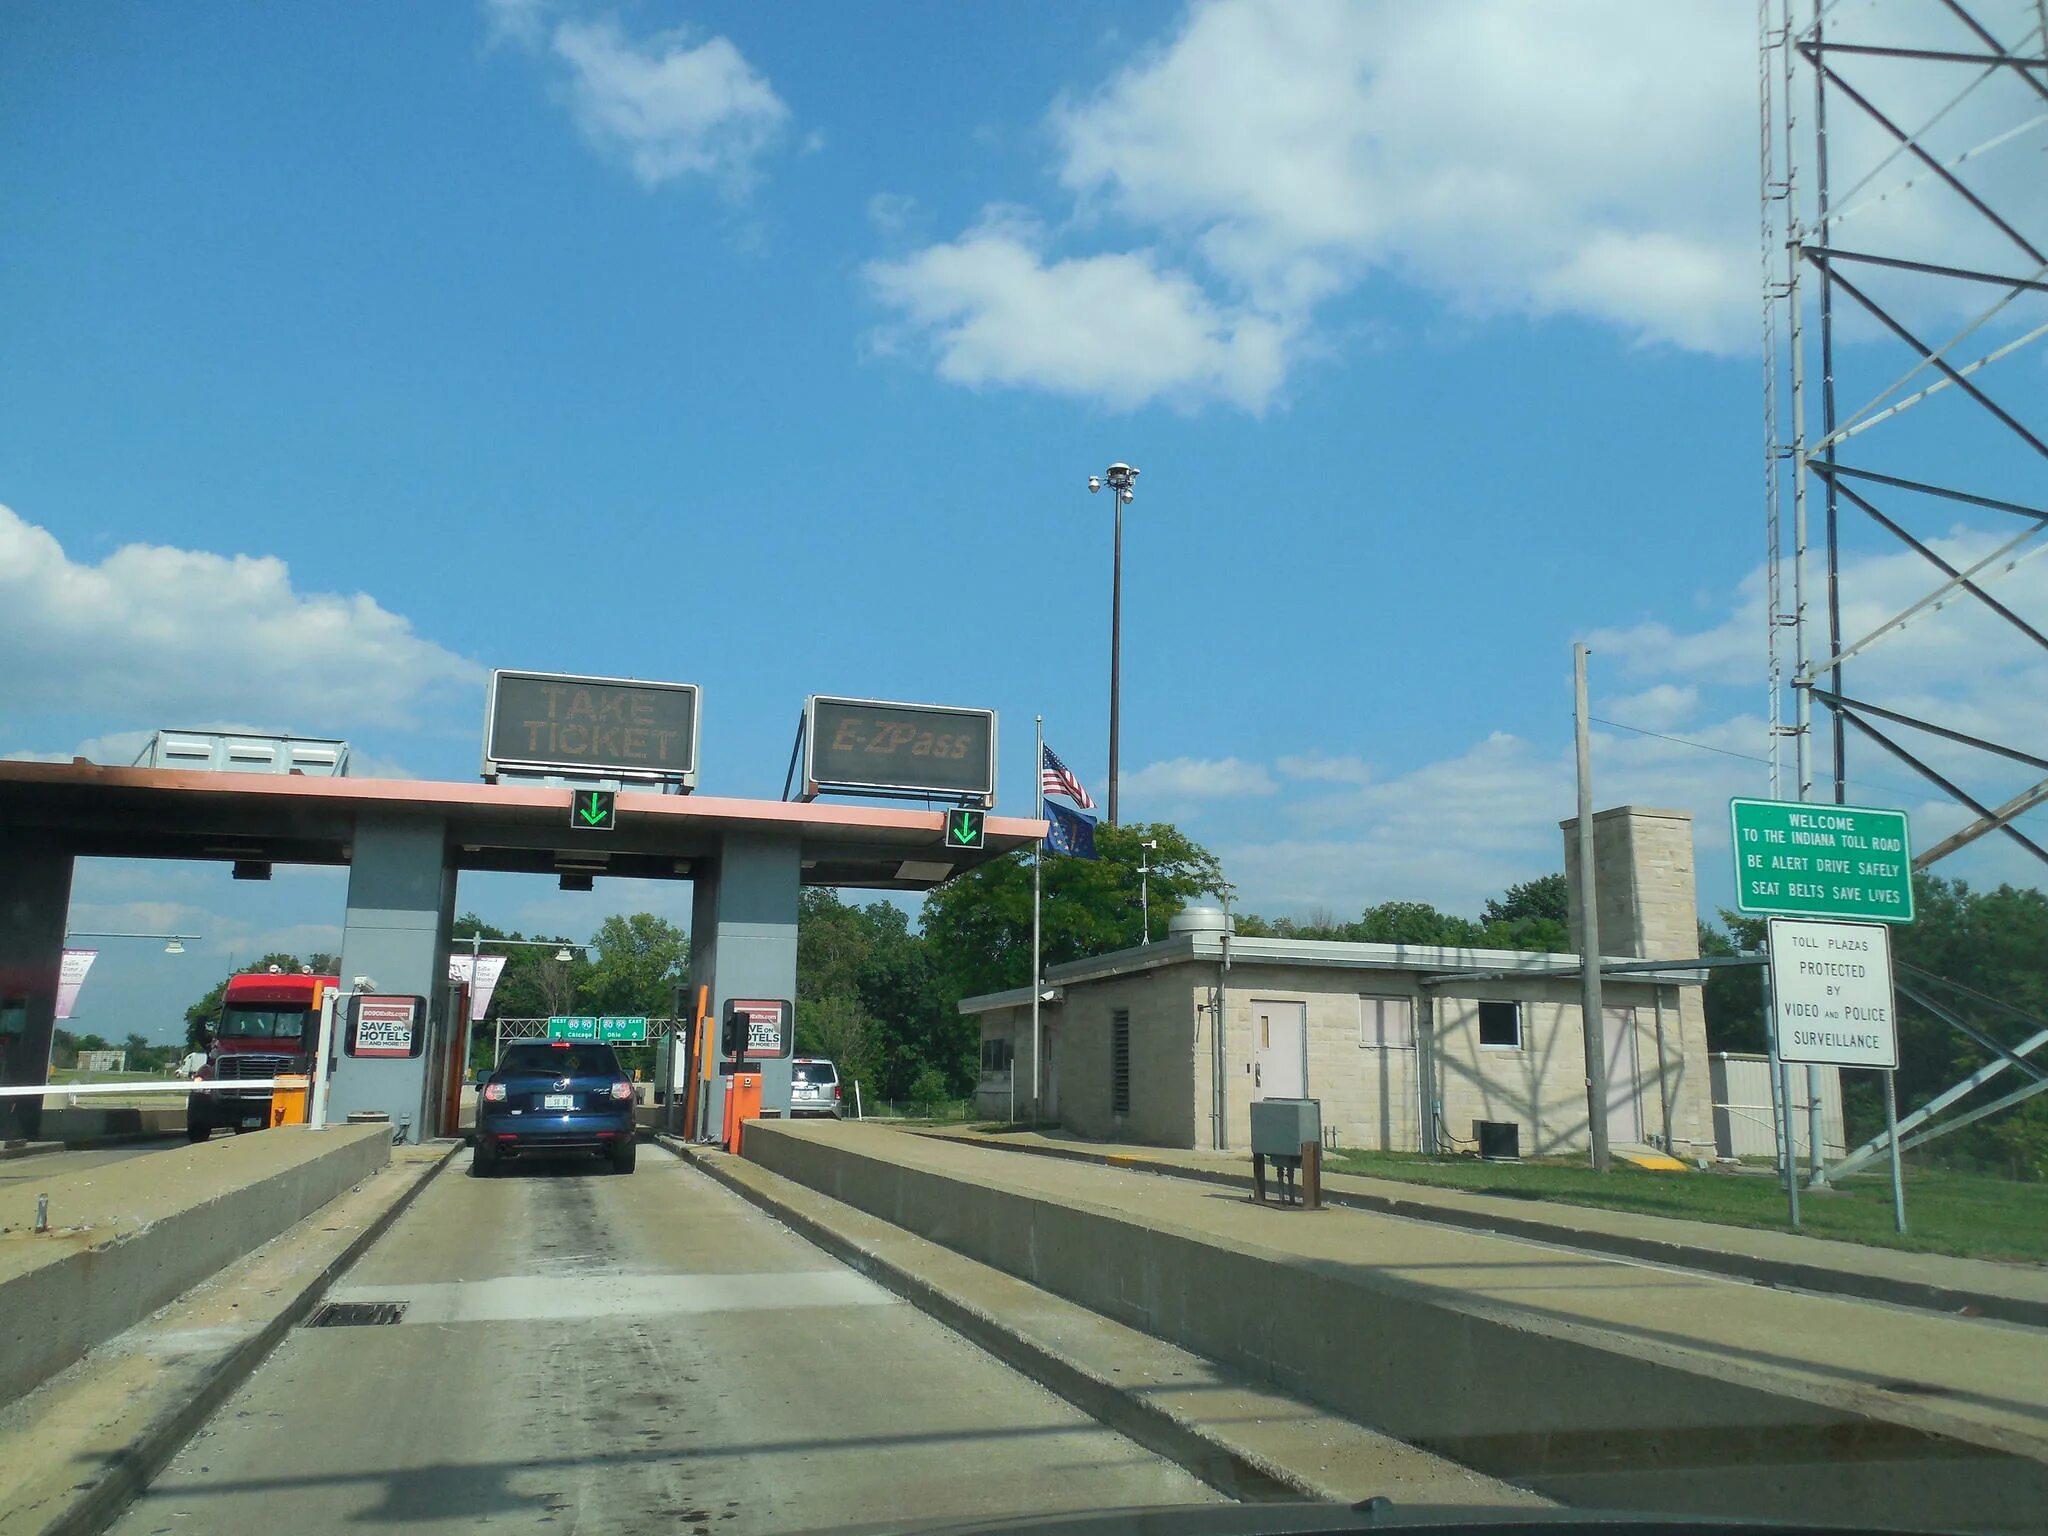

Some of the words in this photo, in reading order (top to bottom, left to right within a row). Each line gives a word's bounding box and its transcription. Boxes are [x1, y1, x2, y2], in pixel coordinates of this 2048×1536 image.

[541, 685, 657, 725] TAKE
[523, 720, 679, 760] TICKET
[831, 717, 972, 760] E-ZPass
[1788, 813, 1855, 831] WELCOME
[1743, 828, 1758, 842] TO
[1763, 829, 1786, 844] THE
[1791, 831, 1836, 847] INDIANA
[1841, 835, 1868, 849] TOLL
[1872, 837, 1901, 852] ROAD
[1747, 854, 1763, 868] BE
[1771, 855, 1808, 871] ALERT
[1816, 859, 1850, 874] DRIVE
[1858, 862, 1899, 877] SAFELY
[1752, 881, 1780, 896] SEAT
[1789, 883, 1825, 898] BELTS
[1832, 886, 1862, 901] SAVE
[1868, 888, 1900, 904] LIVES
[1792, 936, 1819, 949] TOLL
[1828, 939, 1869, 952] PLAZAS
[1799, 961, 1866, 978] PROTECTED
[1826, 985, 1841, 996] BY
[1785, 1003, 1819, 1017] VIDEO
[1825, 1011, 1839, 1019] AND
[1844, 1006, 1886, 1022] POLICE
[361, 1021, 392, 1031] SAVE
[749, 1024, 763, 1033] VE
[359, 1031, 410, 1041] HOTELS
[1794, 1030, 1880, 1049] SURVEILLANCE
